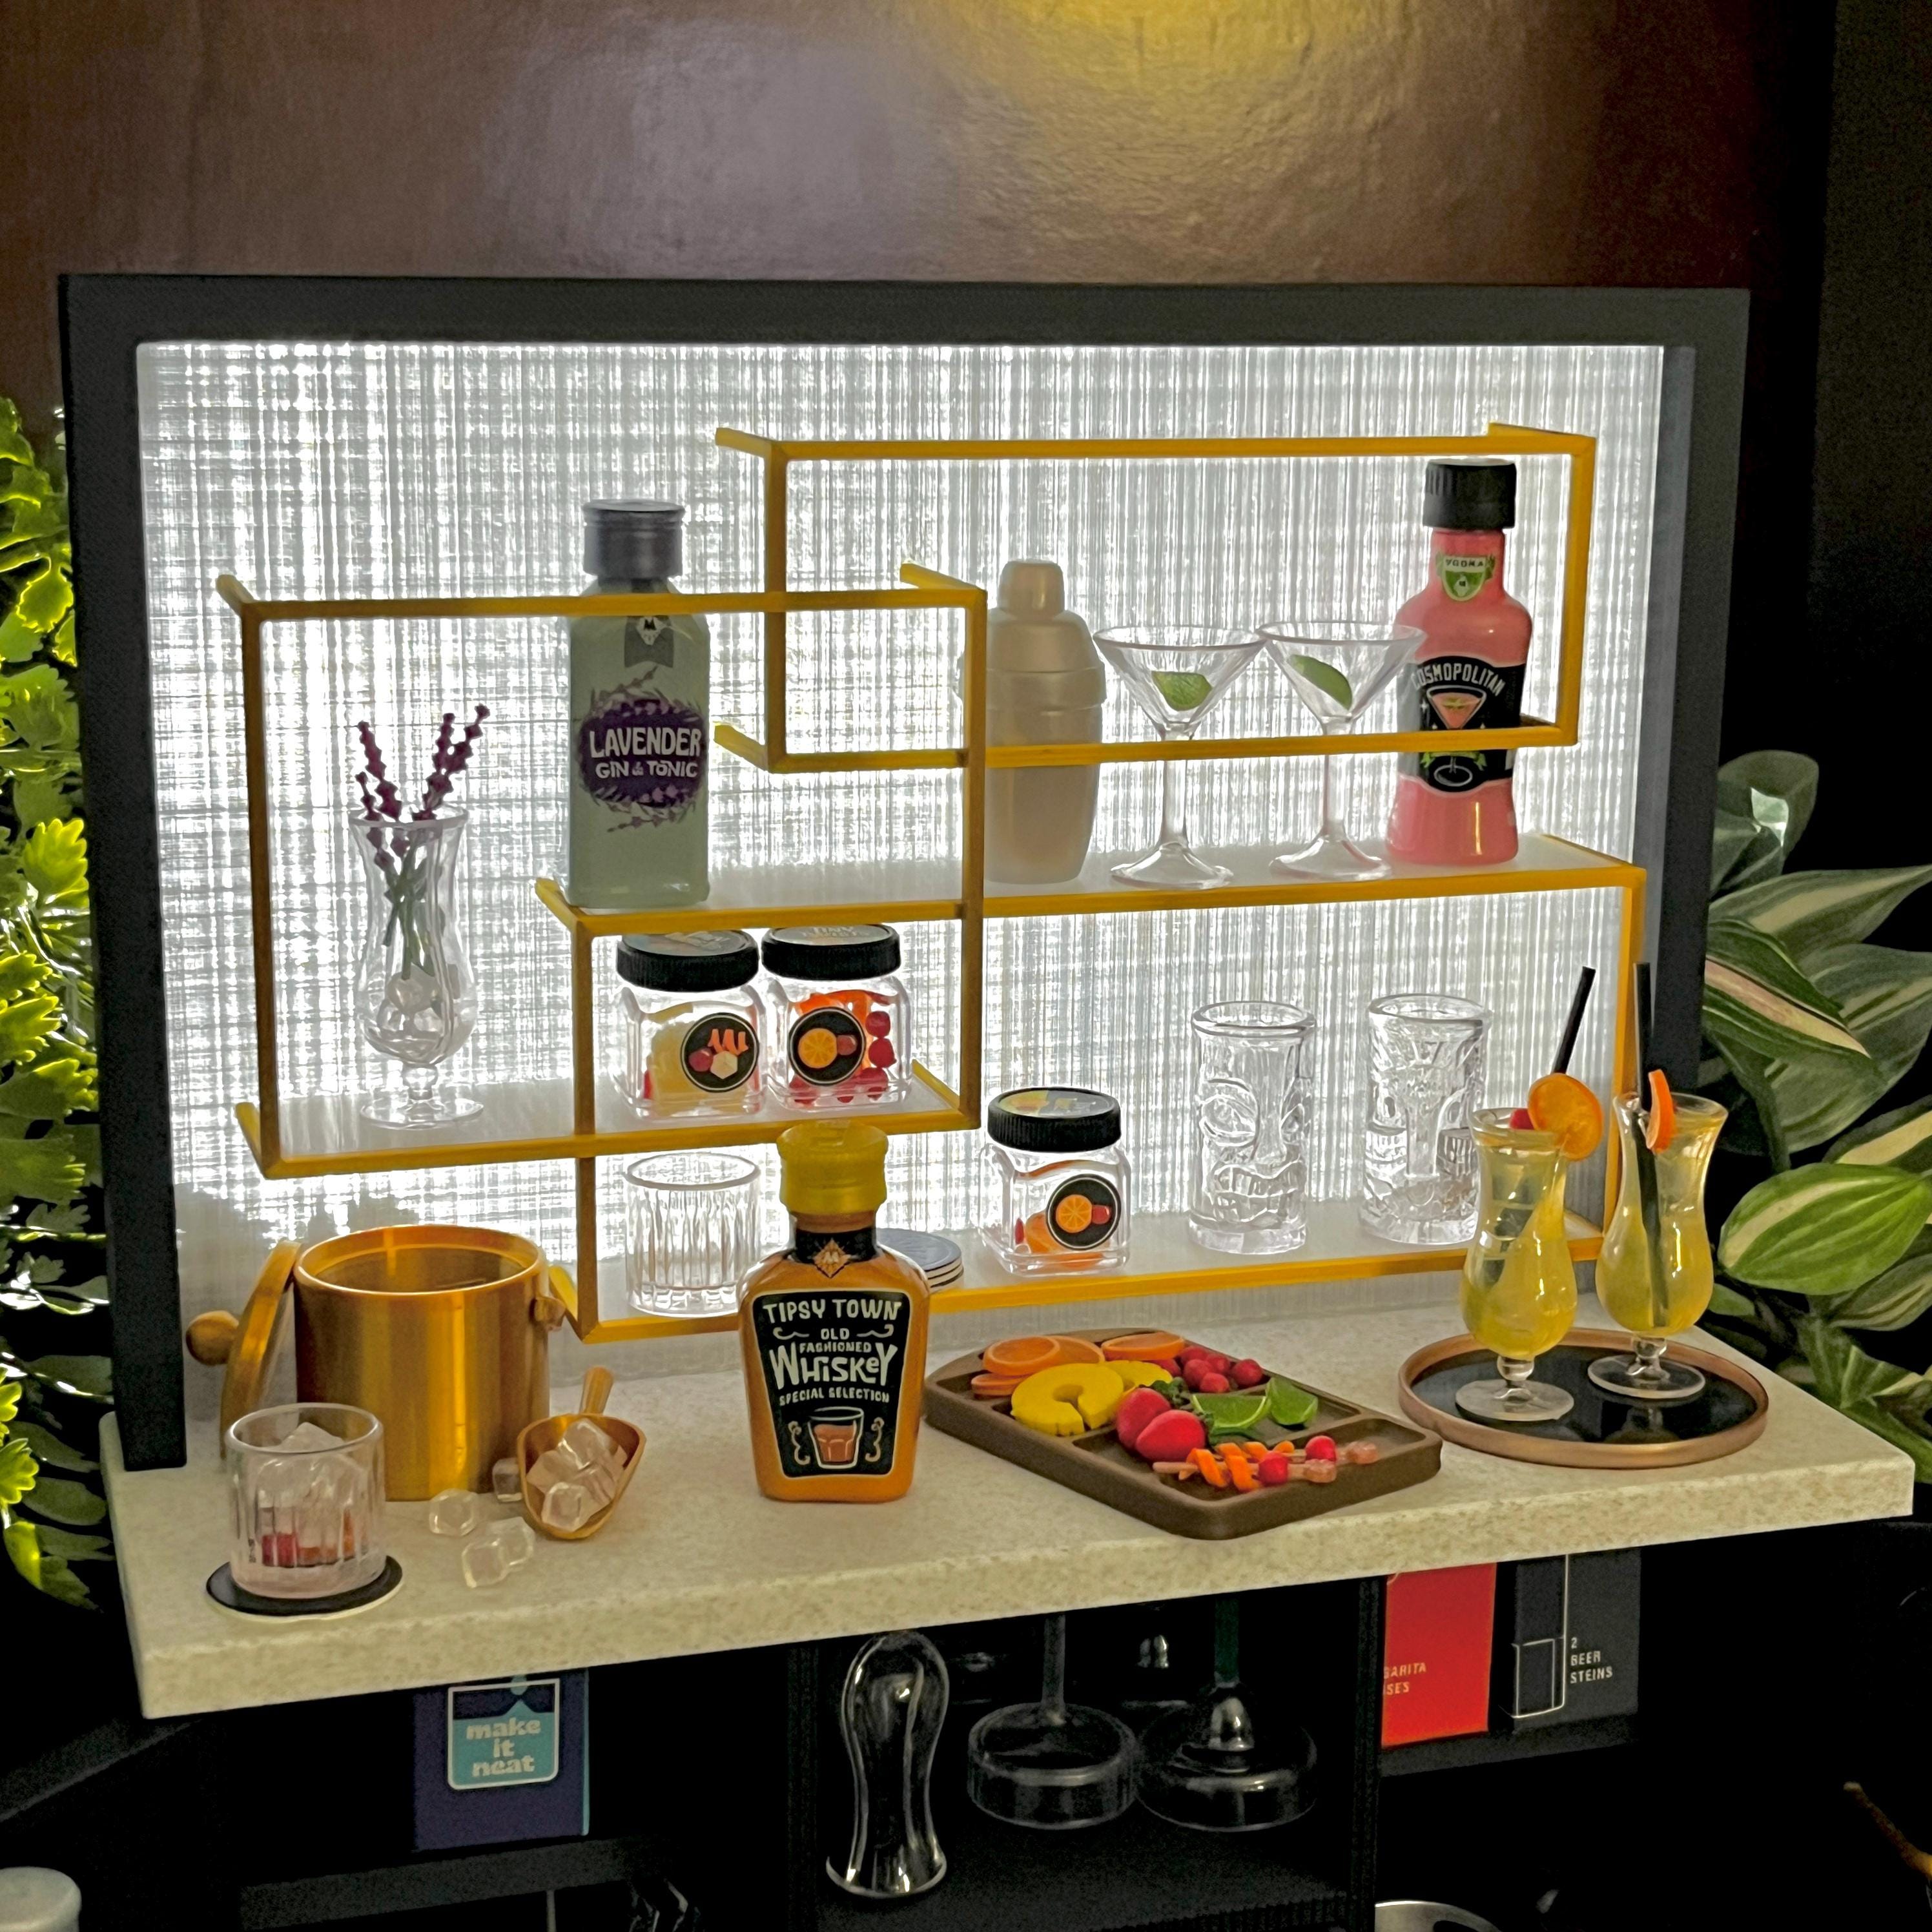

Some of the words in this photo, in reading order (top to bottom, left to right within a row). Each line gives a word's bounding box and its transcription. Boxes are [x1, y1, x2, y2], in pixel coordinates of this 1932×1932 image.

[1411, 663, 1506, 697] COSMOPOLITAN
[590, 727, 702, 758] LAVENDER
[595, 761, 630, 779] GIN
[632, 761, 644, 776] &
[646, 760, 699, 777] TONIC
[763, 1299, 826, 1324] TIPSY
[832, 1299, 902, 1321] TOWN
[821, 1328, 850, 1341] OLD
[799, 1341, 872, 1354] FASHIONED
[779, 1388, 825, 1406] SPECIAL
[828, 1387, 890, 1403] SELECTION
[1571, 1637, 1577, 1649] 2
[1570, 1650, 1601, 1666] BEER
[1570, 1666, 1613, 1684] STEINS
[466, 1718, 541, 1740] make
[493, 1738, 515, 1758] it
[471, 1755, 535, 1777] neat
